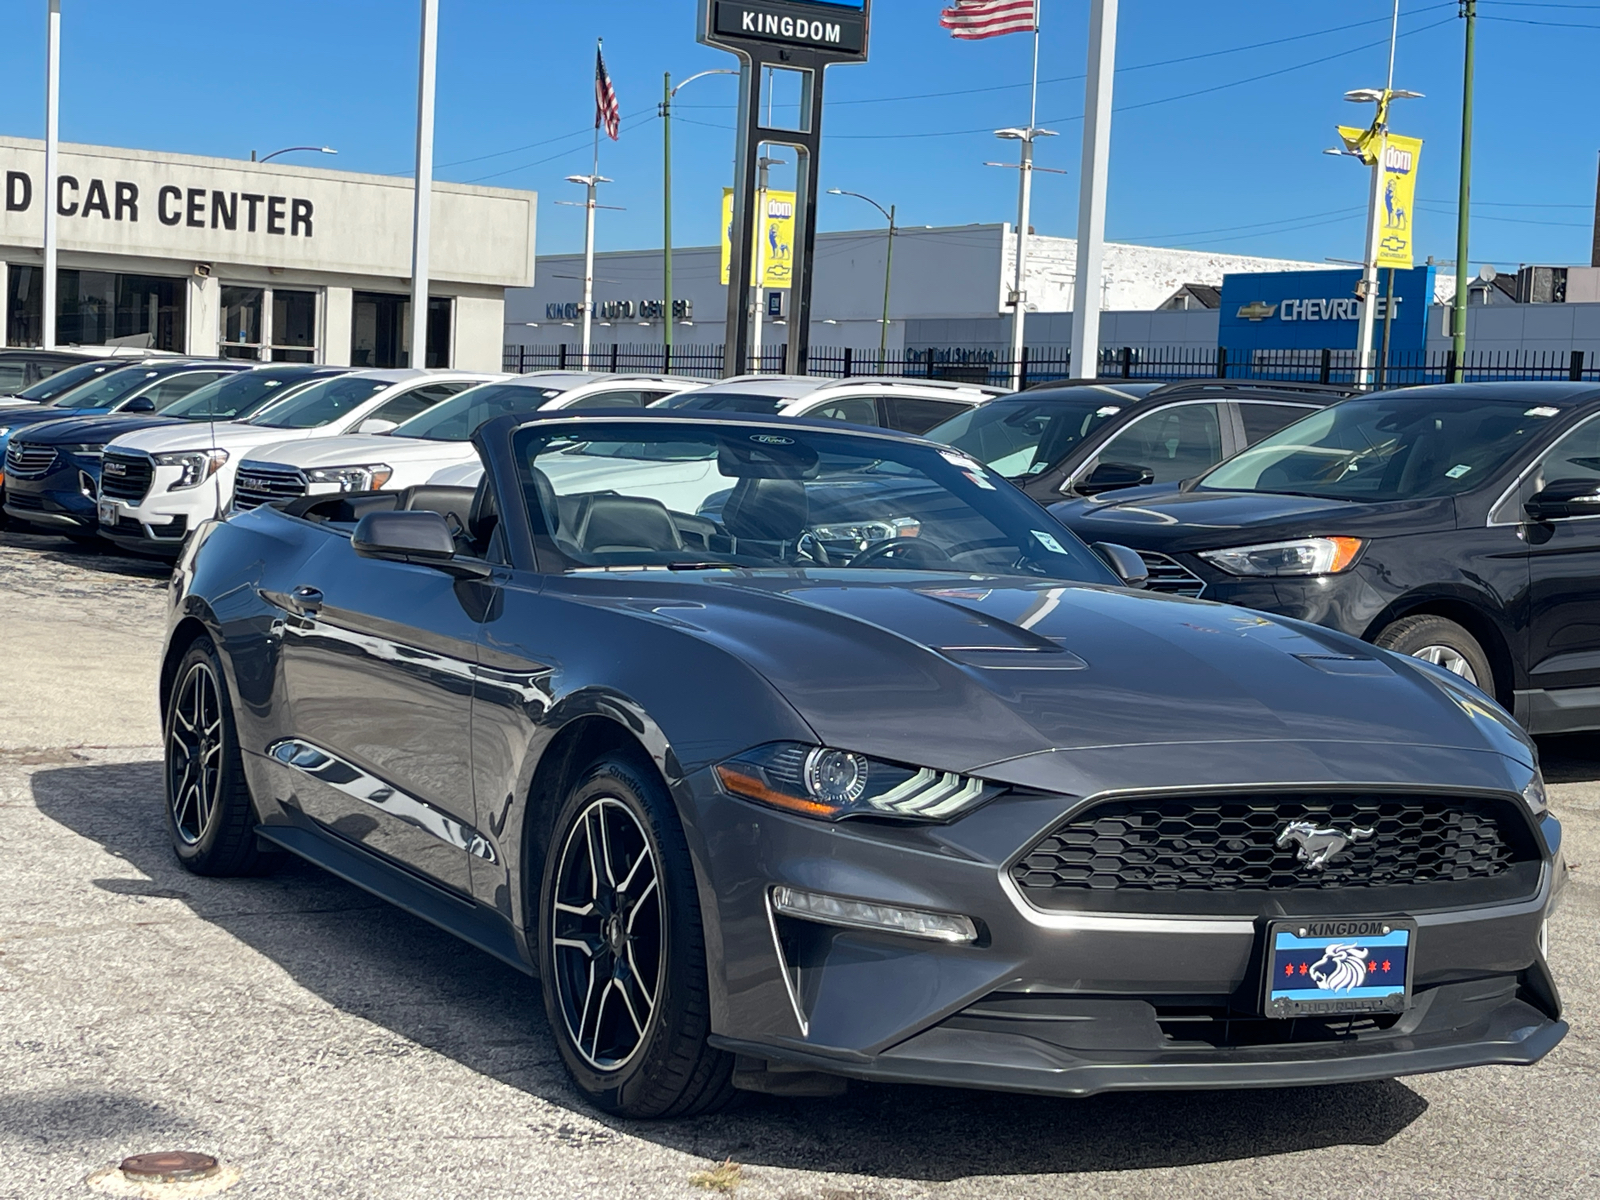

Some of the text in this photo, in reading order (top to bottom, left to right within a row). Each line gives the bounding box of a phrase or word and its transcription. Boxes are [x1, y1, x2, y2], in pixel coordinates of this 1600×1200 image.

[742, 11, 841, 43] KINGDOM
[1386, 146, 1411, 174] dom
[57, 175, 139, 222] CAR
[158, 185, 314, 238] CENTER
[768, 199, 792, 219] dom
[601, 300, 636, 319] AUTO
[640, 299, 693, 319] CENER
[1280, 297, 1403, 320] CHEVROET
[1308, 922, 1383, 936] KINGDOM
